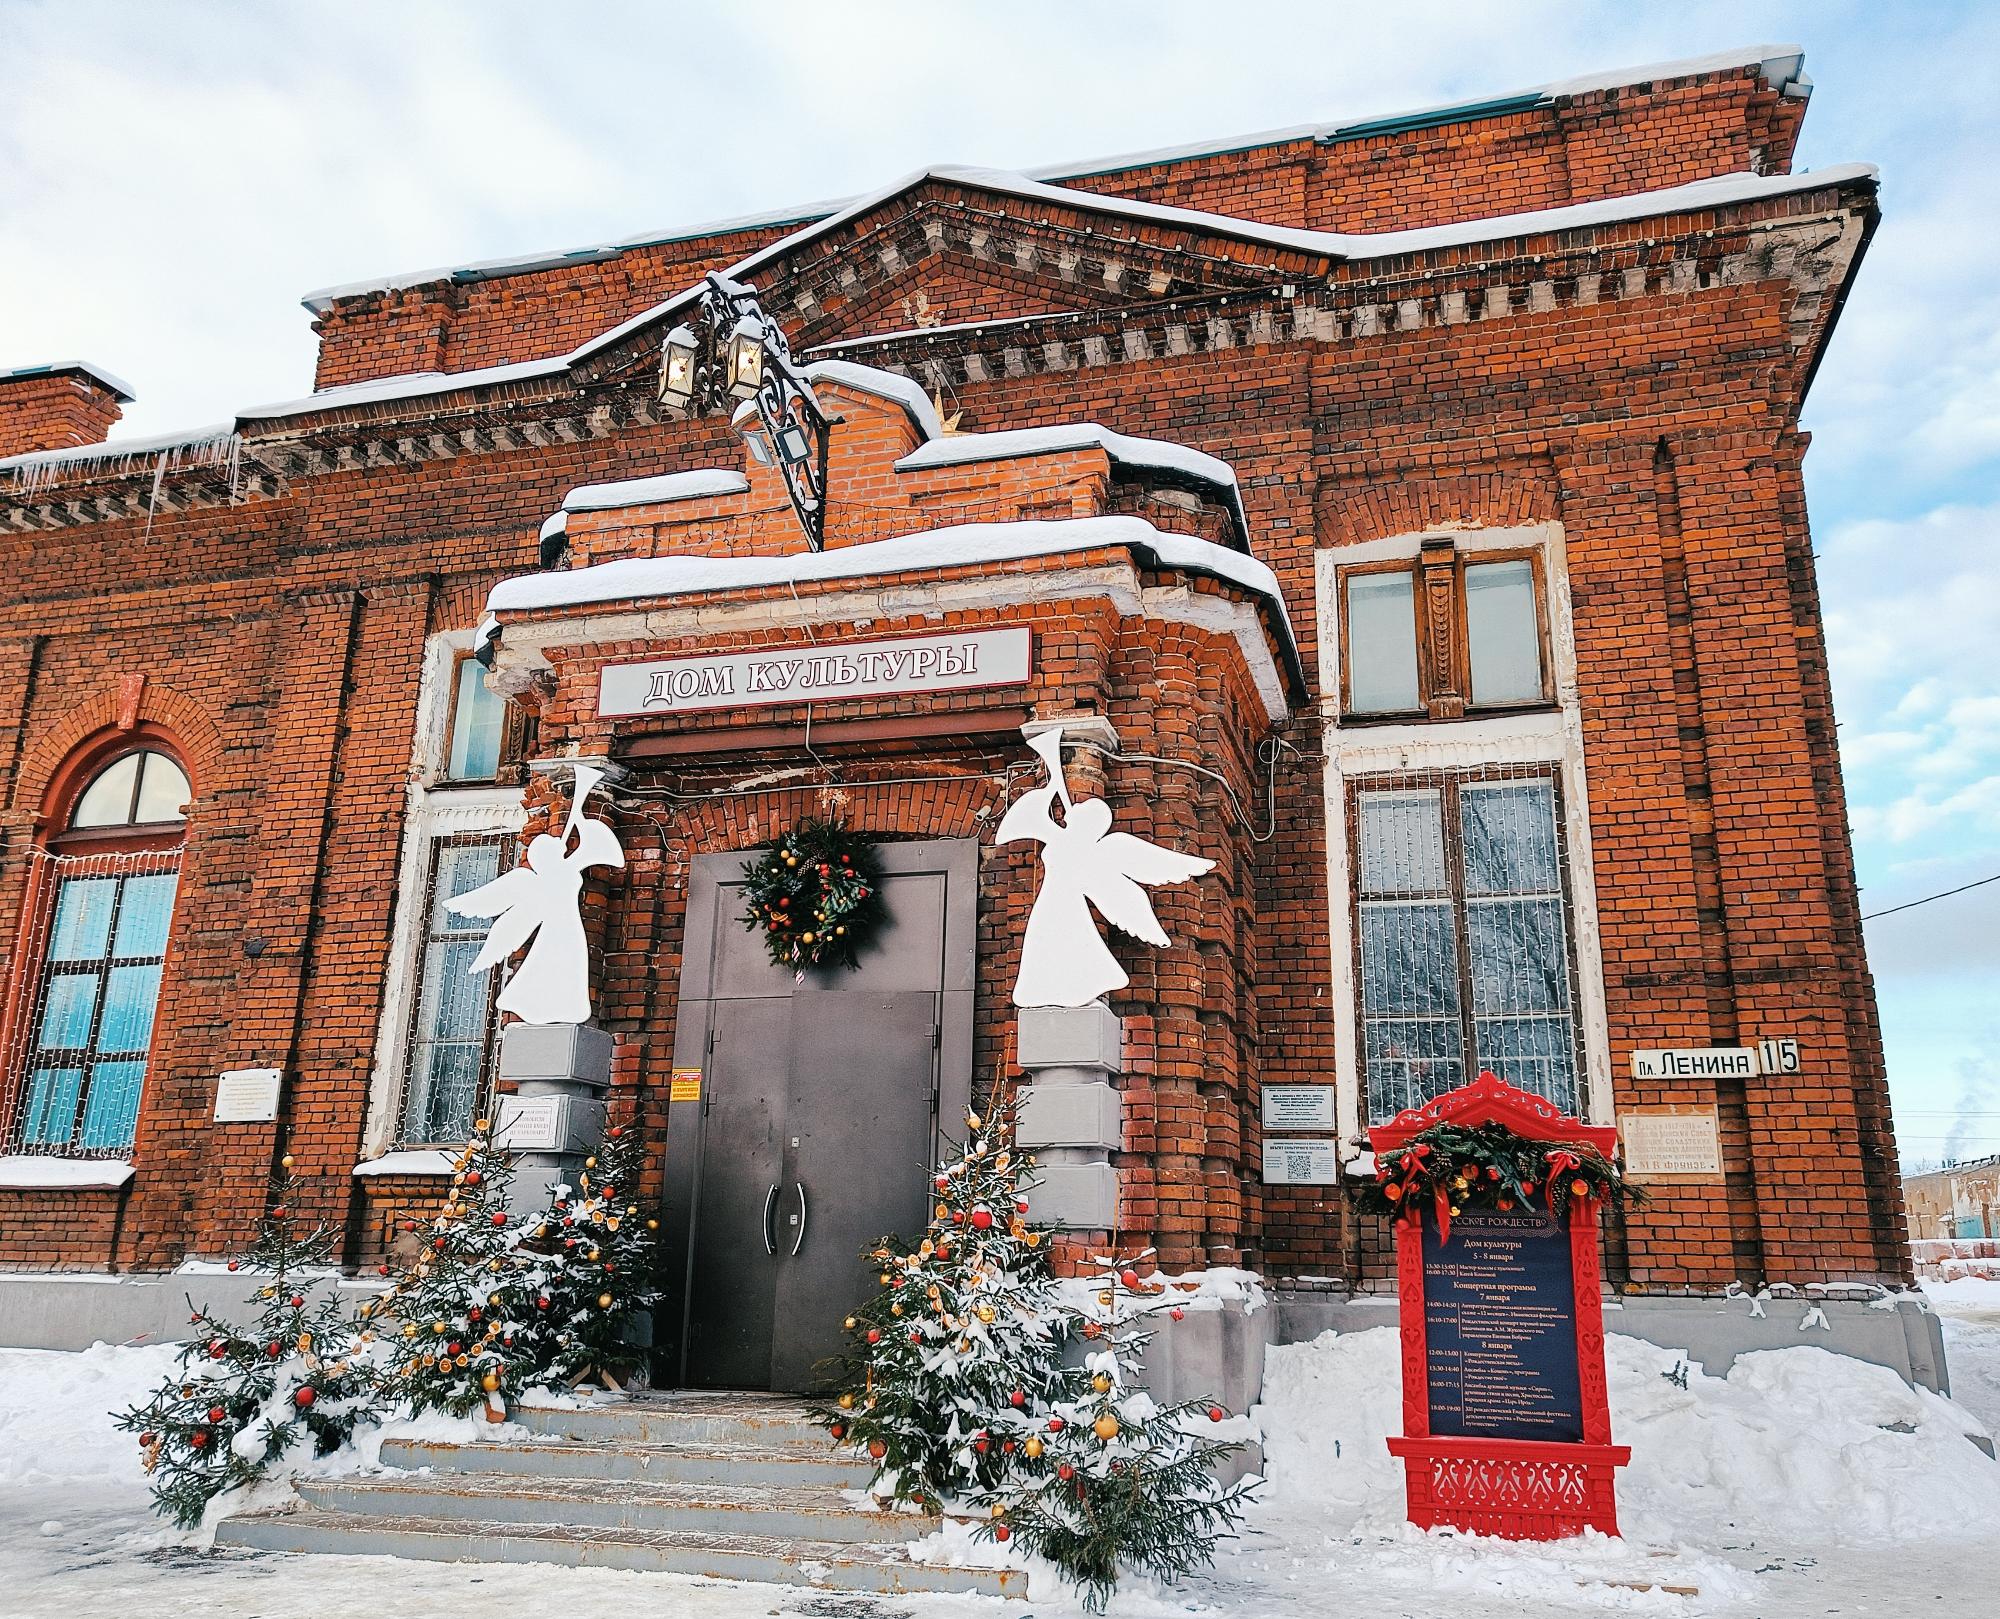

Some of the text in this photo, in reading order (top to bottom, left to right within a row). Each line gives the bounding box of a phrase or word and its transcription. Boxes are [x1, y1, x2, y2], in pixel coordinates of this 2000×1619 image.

[642, 643, 978, 708] ДОМ КУЛЬТУРЫ
[1764, 1042, 1798, 1073] 15
[1488, 1216, 1547, 1228] РОЖДЕСТВО
[1464, 1239, 1522, 1251] Дом культуры
[1489, 1253, 1514, 1262] января
[1453, 1281, 1537, 1293] Концертная программа
[1486, 1294, 1511, 1303] января
[1488, 1342, 1513, 1351] января
